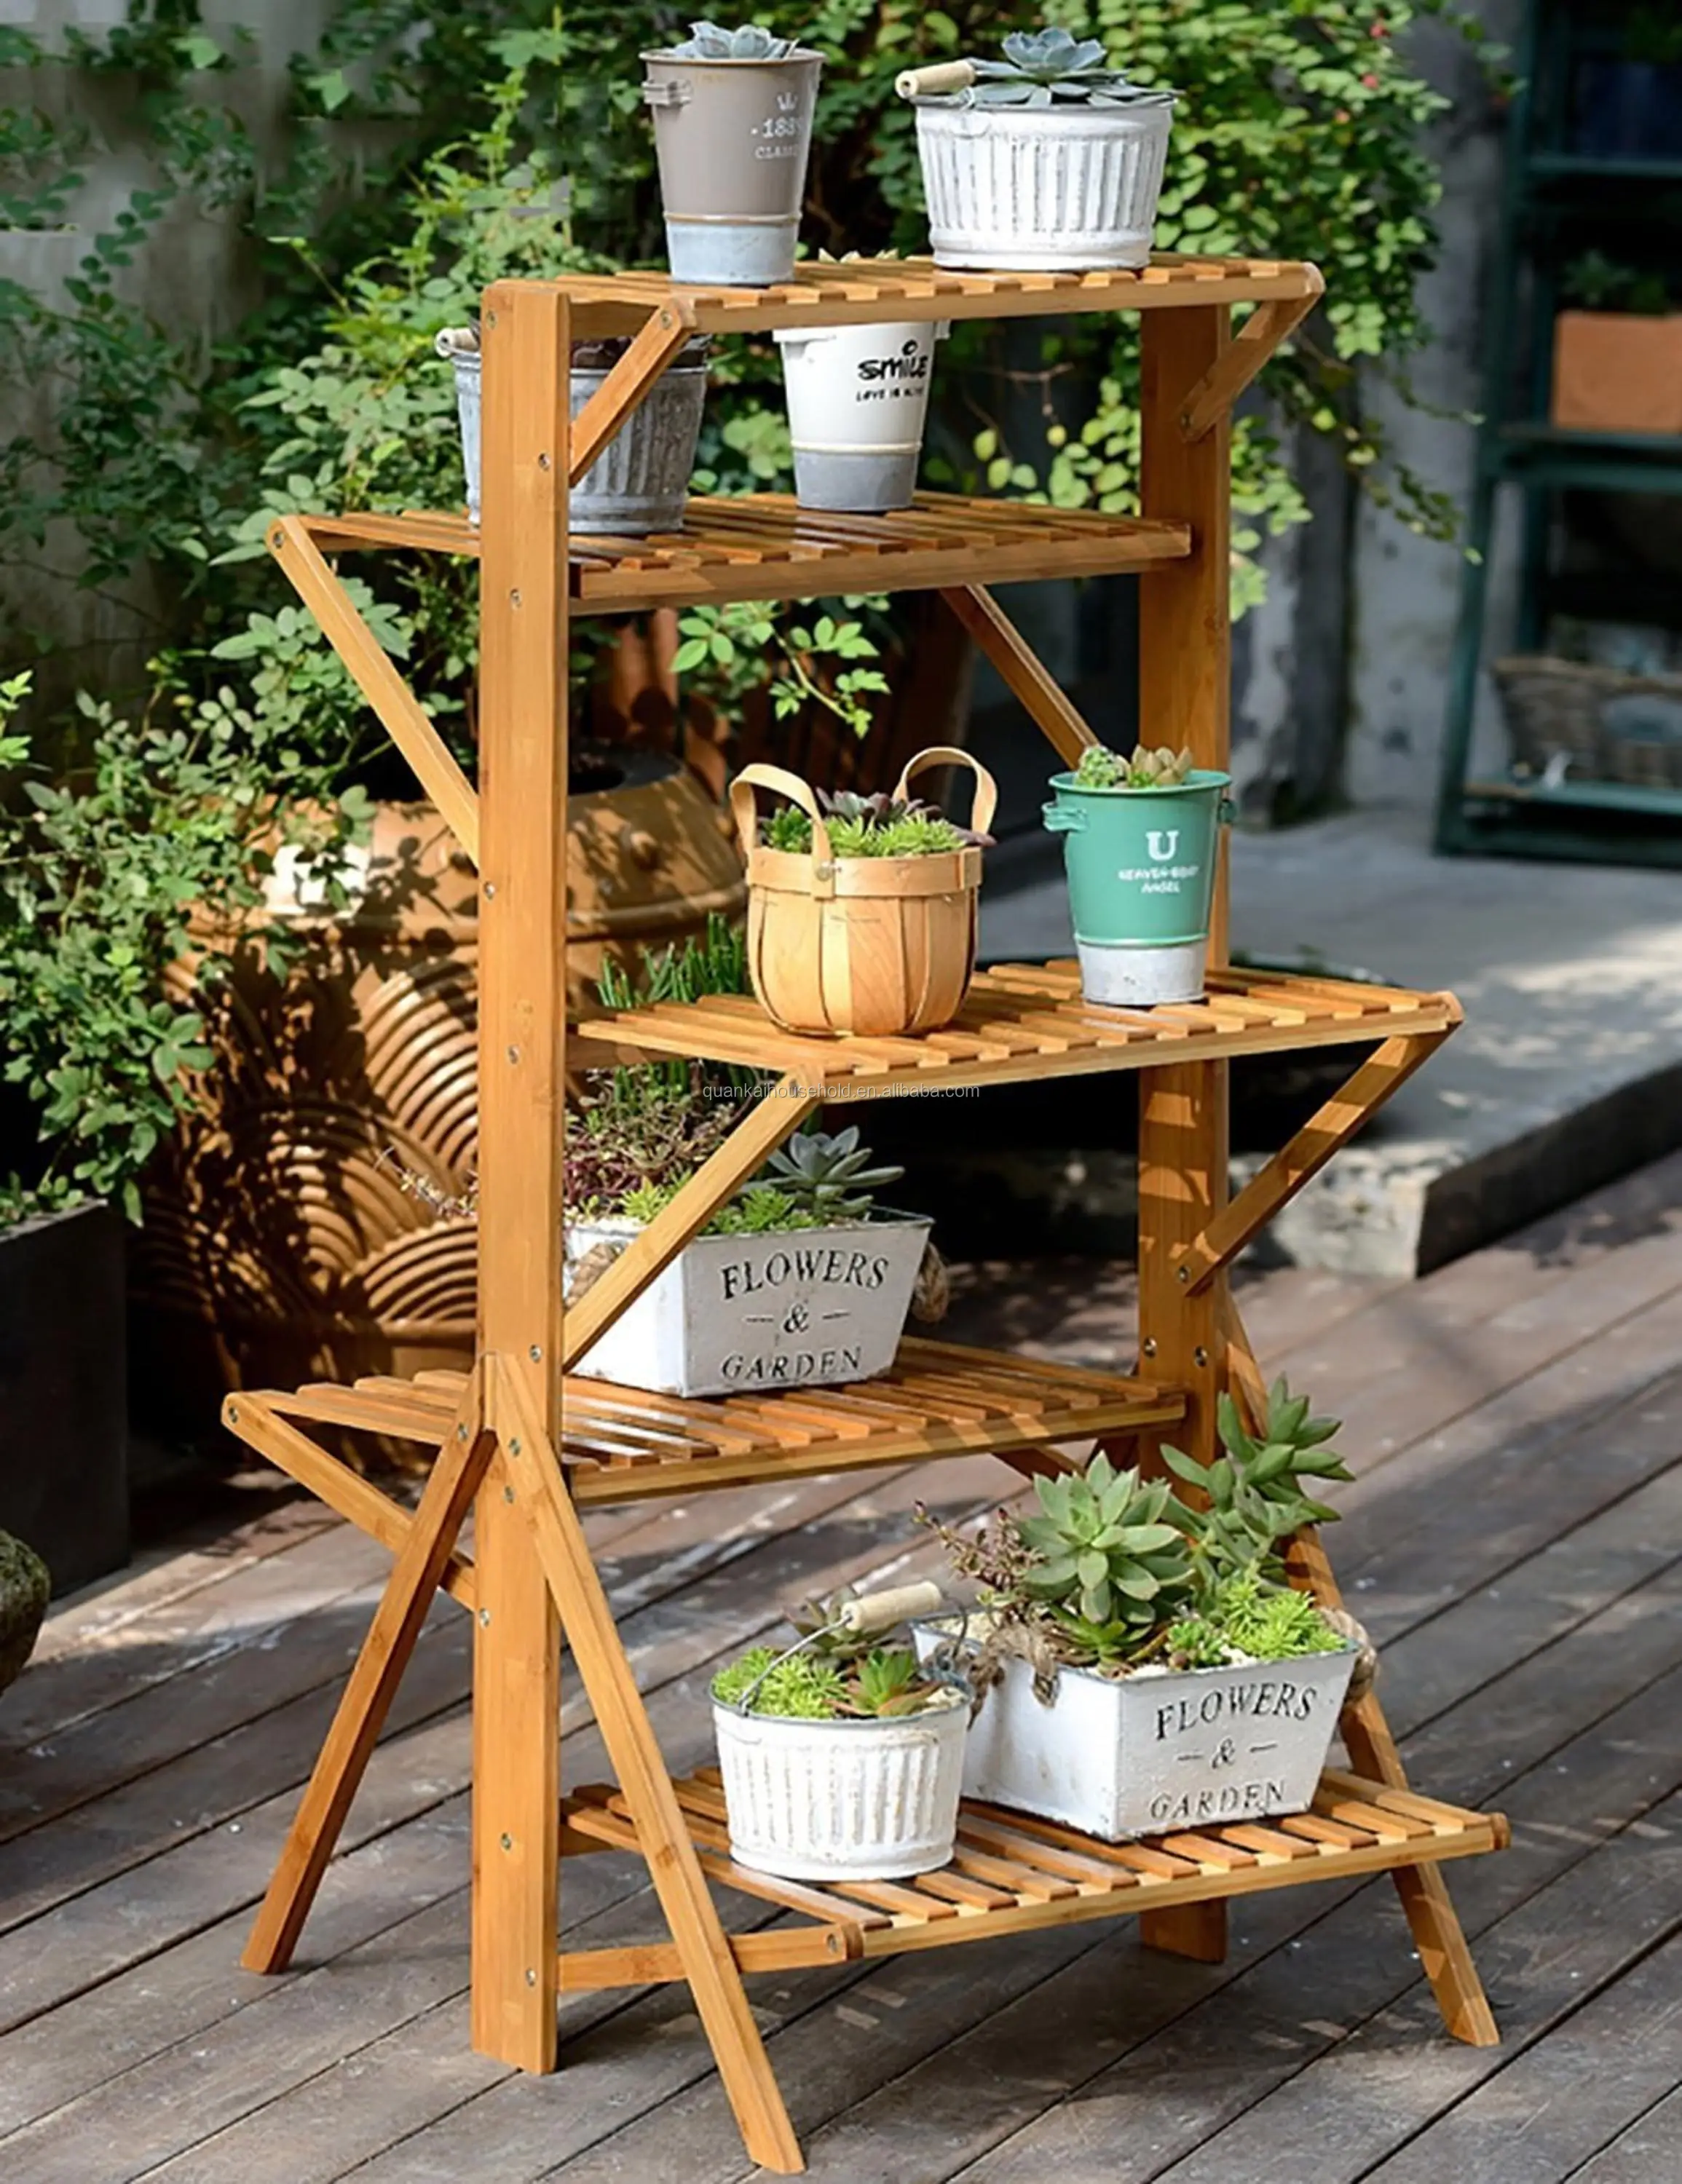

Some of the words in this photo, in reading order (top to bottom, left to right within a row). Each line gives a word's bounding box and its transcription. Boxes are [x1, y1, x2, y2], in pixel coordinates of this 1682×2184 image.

[1145, 830, 1180, 860] U
[720, 1249, 889, 1300] FLOWERS
[782, 1302, 810, 1334] &
[721, 1346, 862, 1380] GARDEN
[1156, 1682, 1317, 1741] FLOWERS
[1211, 1738, 1236, 1770] &
[1149, 1779, 1286, 1821] GARDEN
